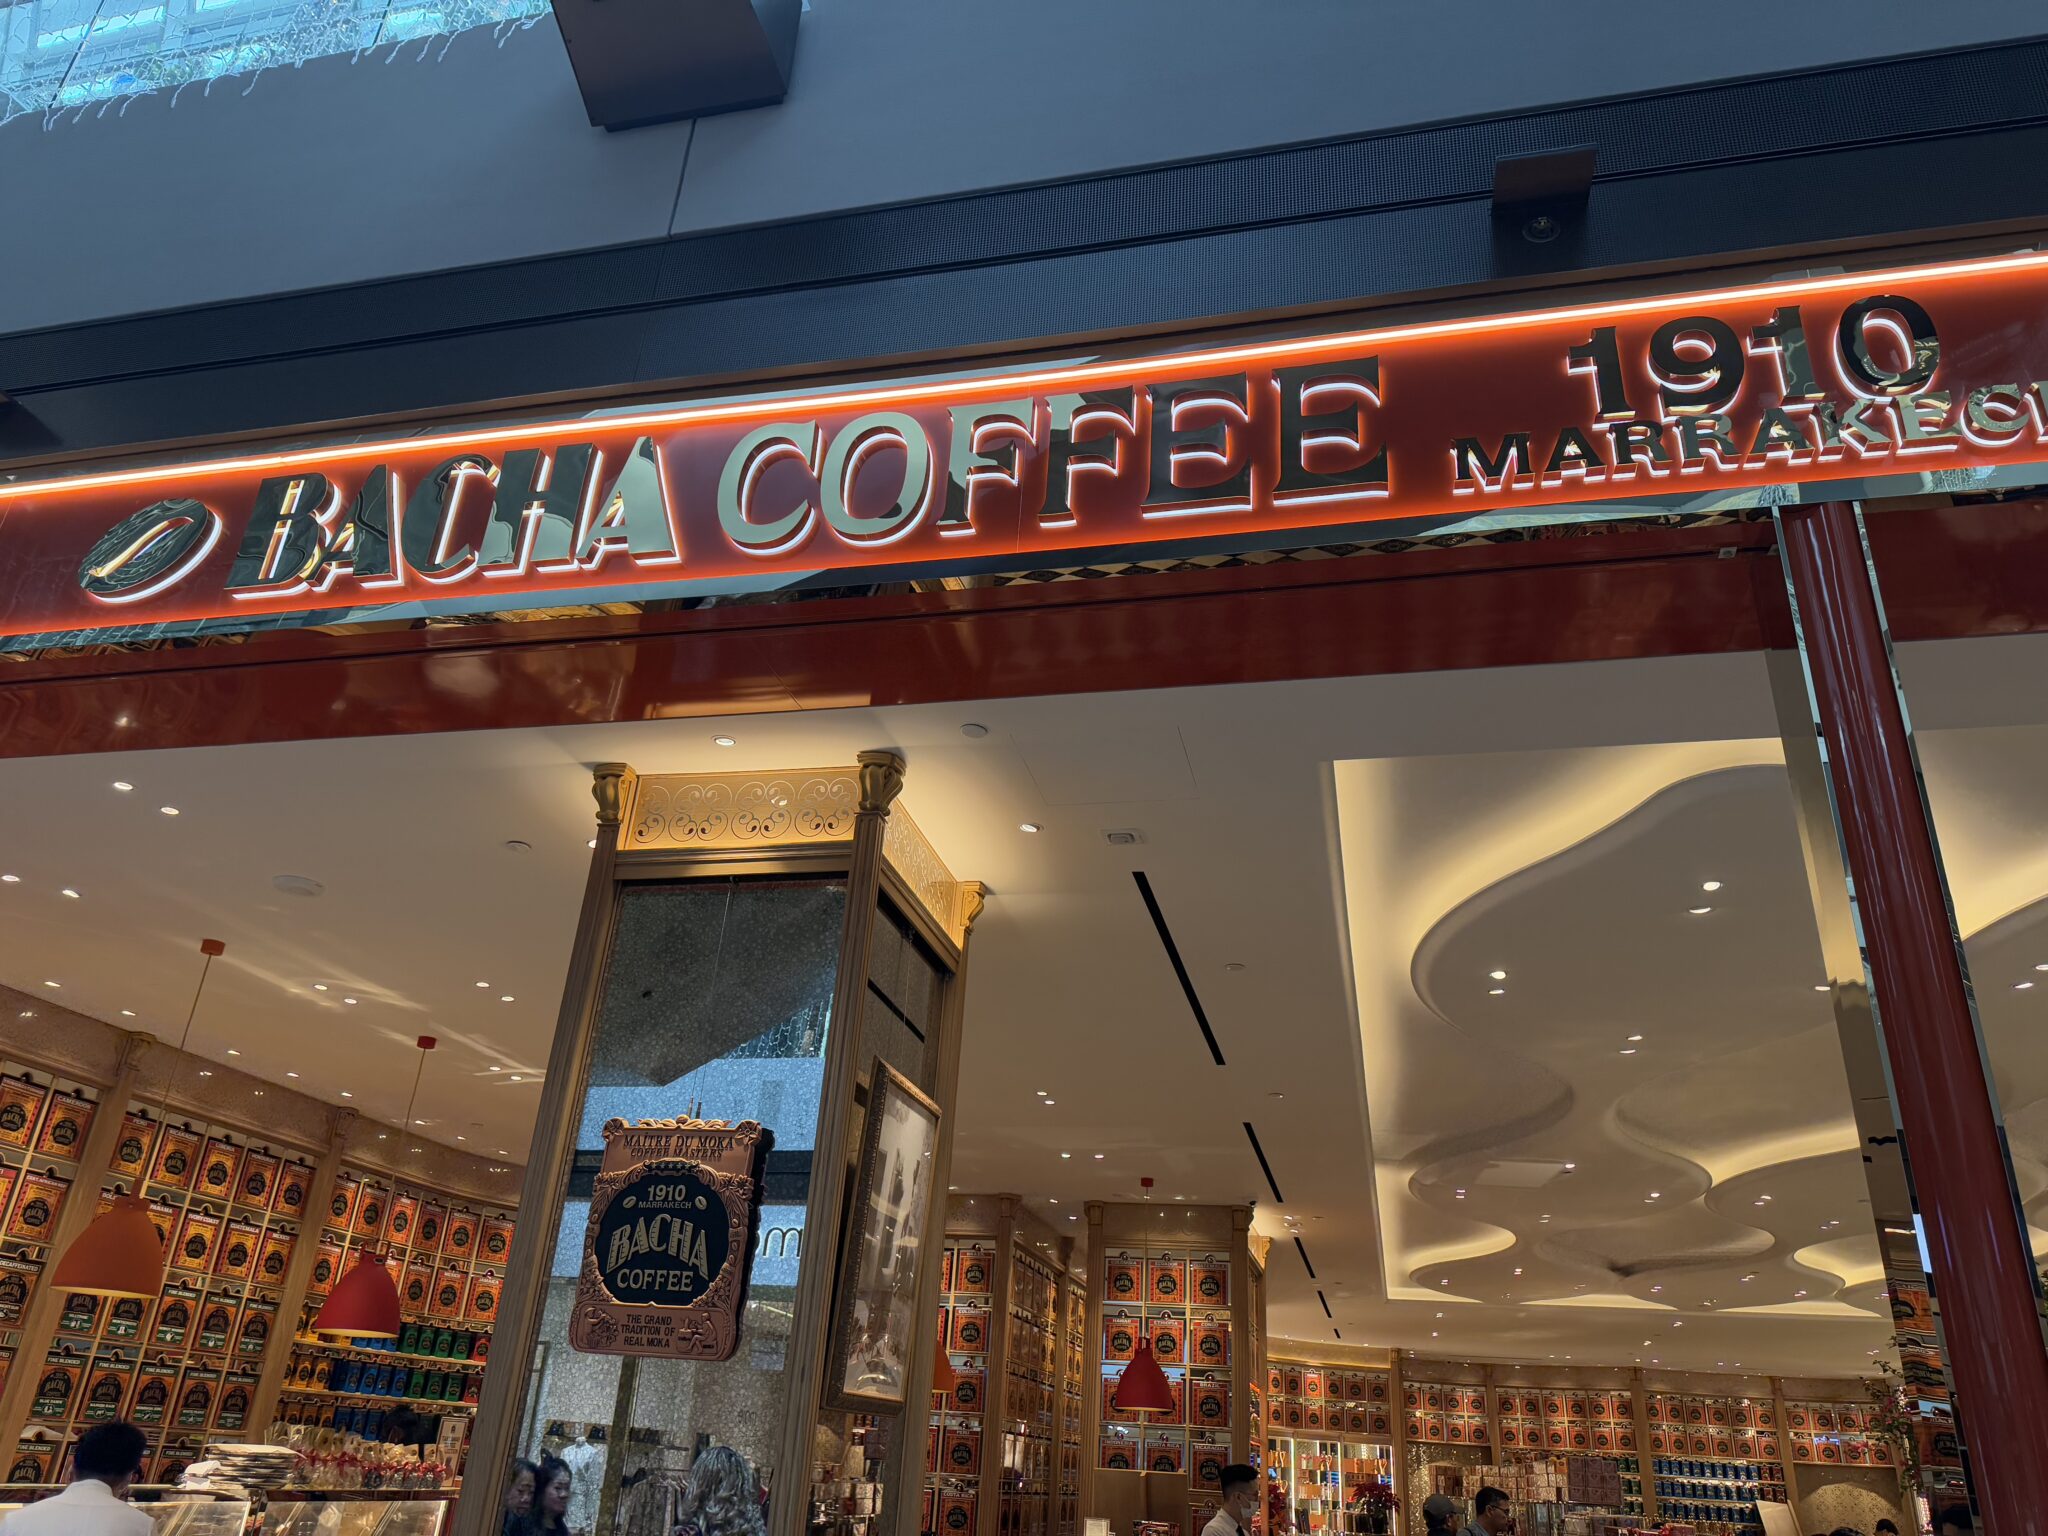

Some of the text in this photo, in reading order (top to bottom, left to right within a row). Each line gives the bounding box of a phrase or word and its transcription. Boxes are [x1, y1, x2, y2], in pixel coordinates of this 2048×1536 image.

[1567, 294, 1941, 430] 1910
[1451, 381, 2048, 495] MARRAKEC
[224, 356, 1389, 602] BACHA COFFEE
[675, 1135, 694, 1148] DU
[697, 1136, 733, 1149] MOKA
[630, 1147, 724, 1158] COFFEE MASTERS
[647, 1184, 686, 1201] 1910
[638, 1200, 692, 1210] MARRAKECH
[606, 1213, 709, 1281] BACHA
[0, 1260, 39, 1272] DECAFFEINATED
[616, 1269, 694, 1293] COFFEE
[626, 1314, 672, 1325] THE GRAND
[621, 1325, 676, 1336] TRADITION OF
[623, 1336, 670, 1348] REAL MOKA
